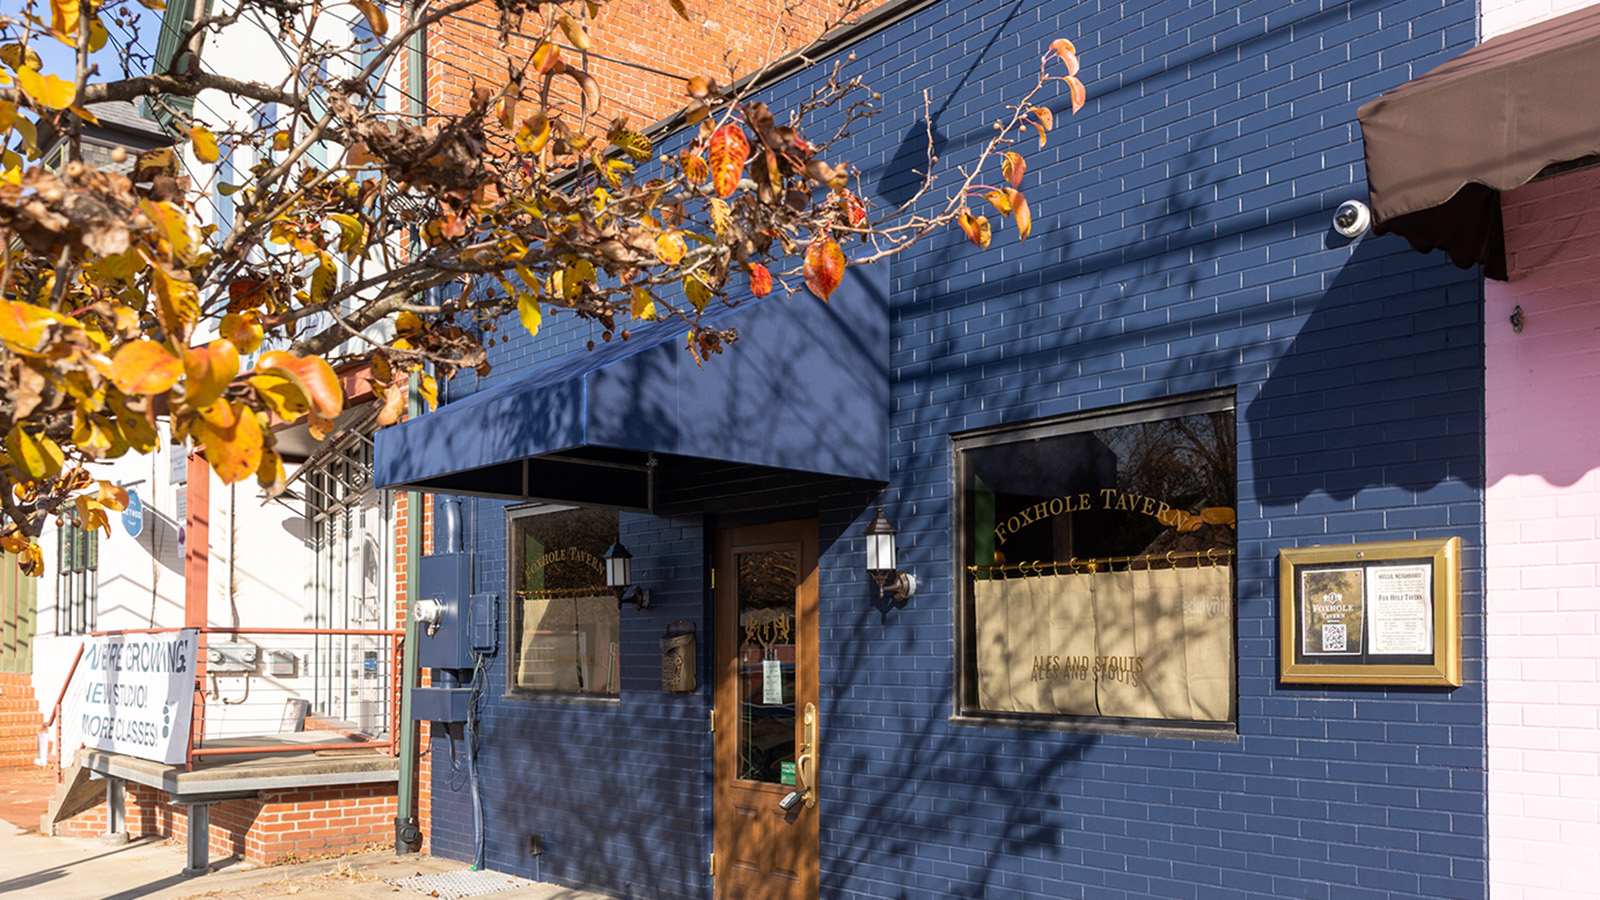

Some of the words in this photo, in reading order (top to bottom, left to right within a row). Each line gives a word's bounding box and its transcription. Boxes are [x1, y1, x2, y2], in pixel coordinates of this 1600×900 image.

[994, 493, 1091, 545] FOXHOLE
[1100, 489, 1188, 531] TAVERN
[525, 549, 566, 580] FOXHOLE
[569, 546, 606, 576] TAVERN
[1312, 604, 1354, 613] FOXHOLE
[126, 639, 189, 673] GROWING!
[1033, 655, 1060, 672] ALES
[1065, 655, 1089, 672] AND
[1095, 655, 1144, 673] STOUTS
[81, 713, 113, 740] MORE
[115, 718, 159, 747] CLASSES!
